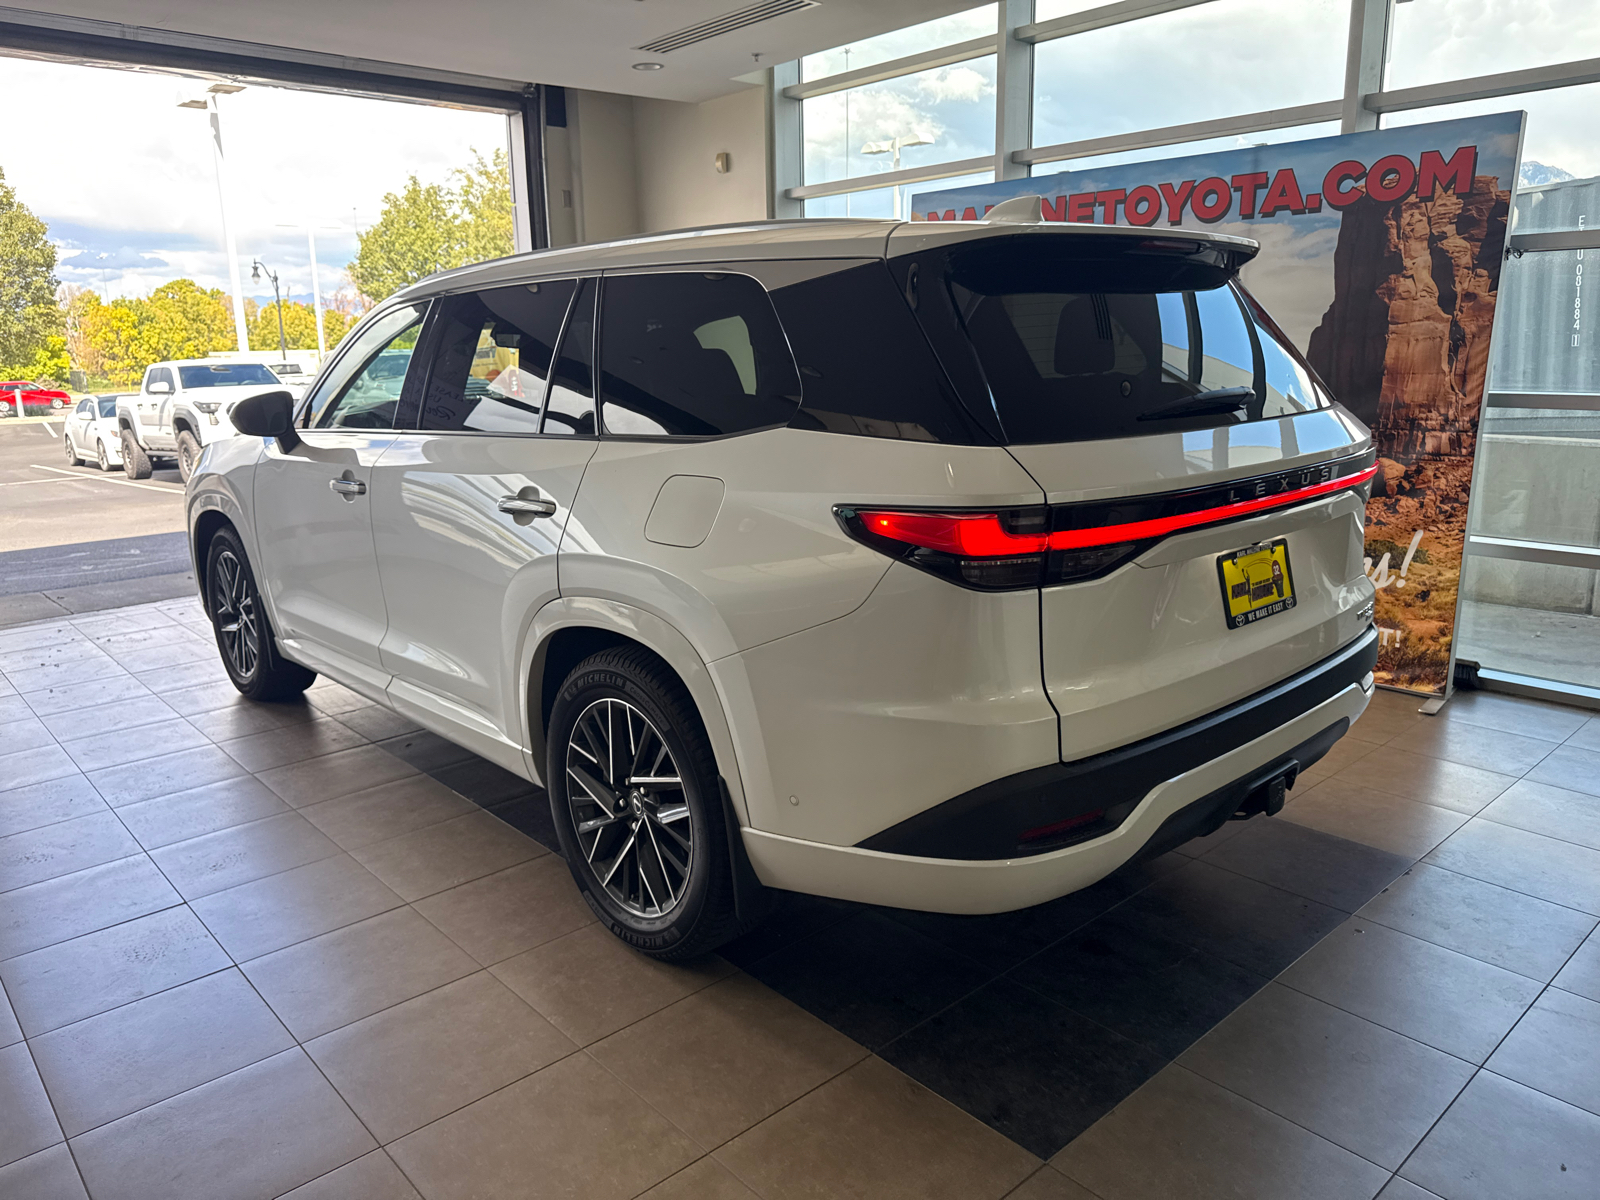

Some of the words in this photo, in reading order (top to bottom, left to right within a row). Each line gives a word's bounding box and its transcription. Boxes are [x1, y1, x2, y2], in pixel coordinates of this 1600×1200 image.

[926, 145, 1478, 226] NETOYOTA.COM
[1573, 264, 1583, 331] 081884
[1230, 468, 1330, 501] LEXUS
[1273, 564, 1281, 575] 32
[1247, 612, 1256, 622] WE
[1255, 607, 1268, 619] MAKE
[1272, 602, 1285, 613] EASY
[577, 673, 623, 689] MICHELIN
[613, 924, 664, 947] MICHELIN
